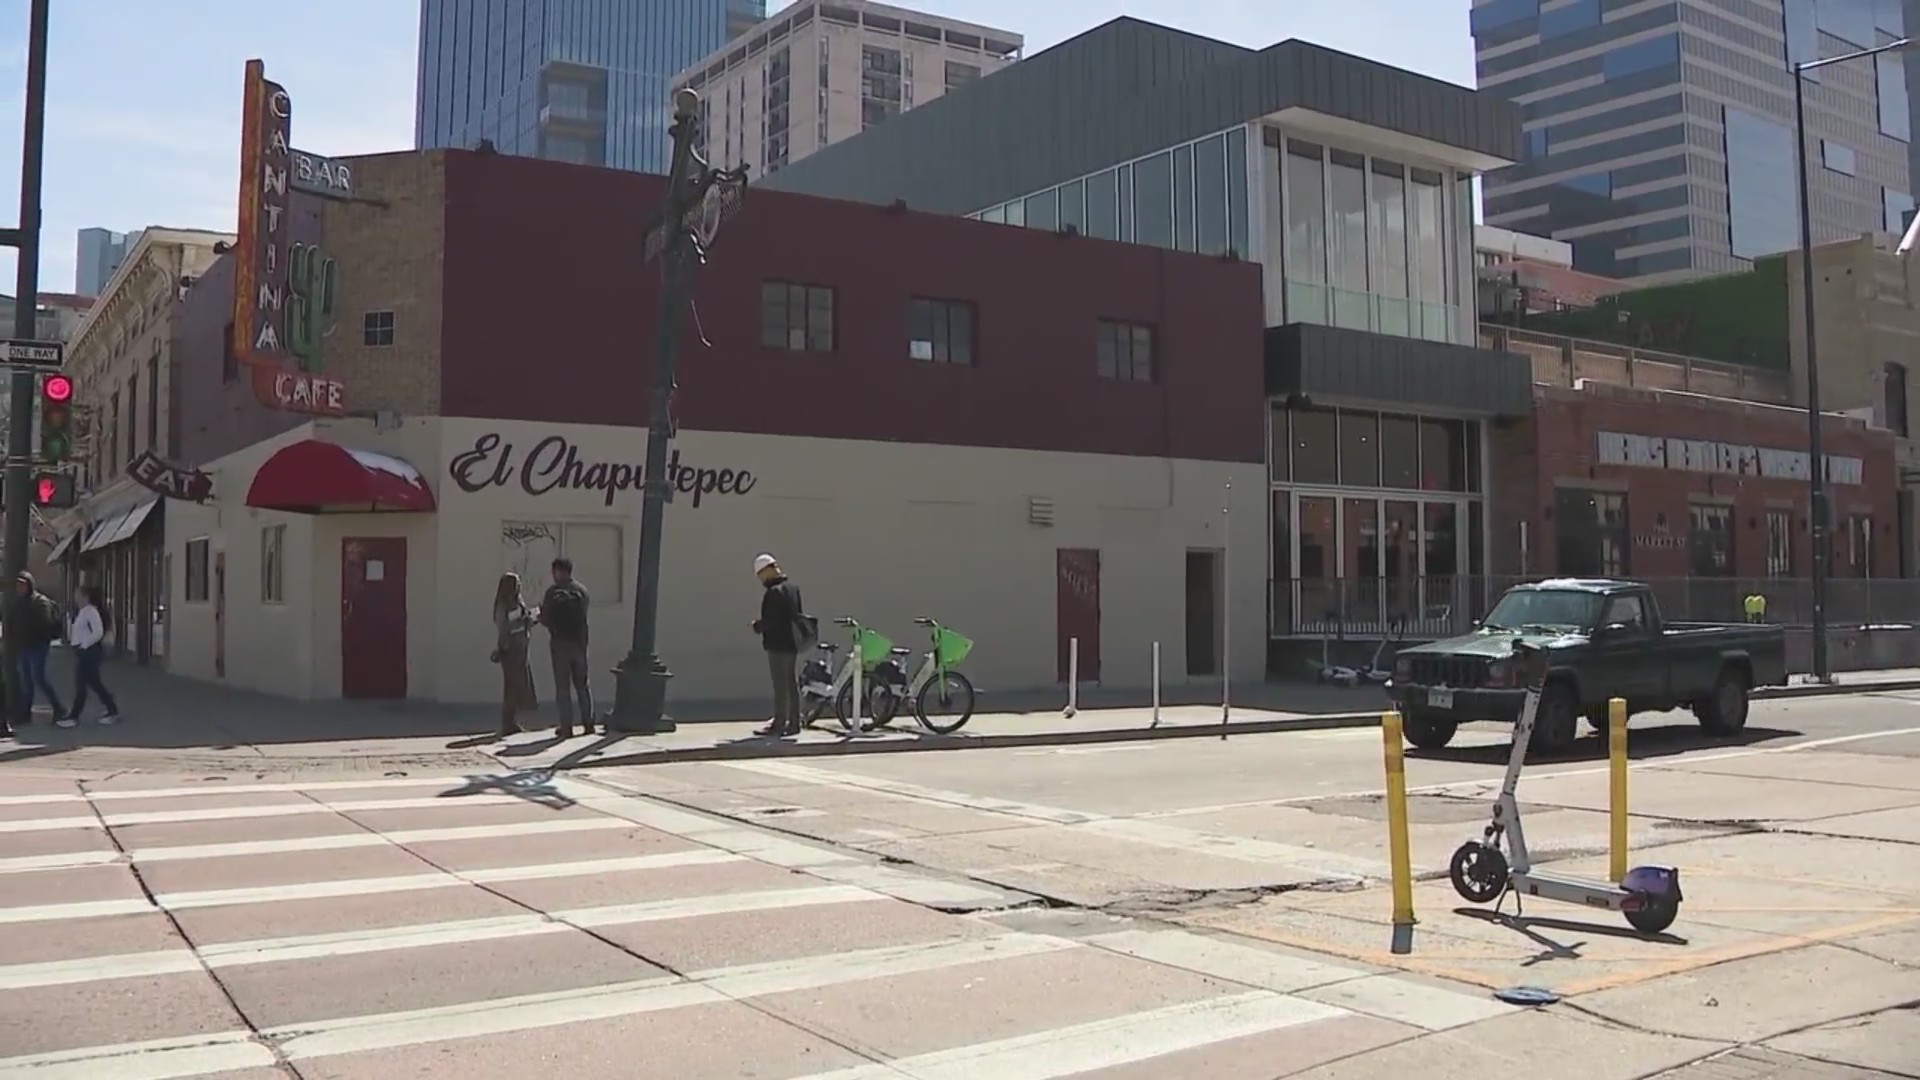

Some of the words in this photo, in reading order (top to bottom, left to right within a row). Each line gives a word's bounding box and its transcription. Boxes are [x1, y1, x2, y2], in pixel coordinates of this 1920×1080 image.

[297, 154, 351, 191] BAR
[256, 90, 290, 350] CANTINA
[10, 346, 30, 358] ONE
[34, 348, 55, 359] WAY
[275, 374, 344, 409] CAFE
[136, 456, 197, 498] EAT
[449, 433, 513, 493] El
[520, 435, 757, 509] Chaputepec
